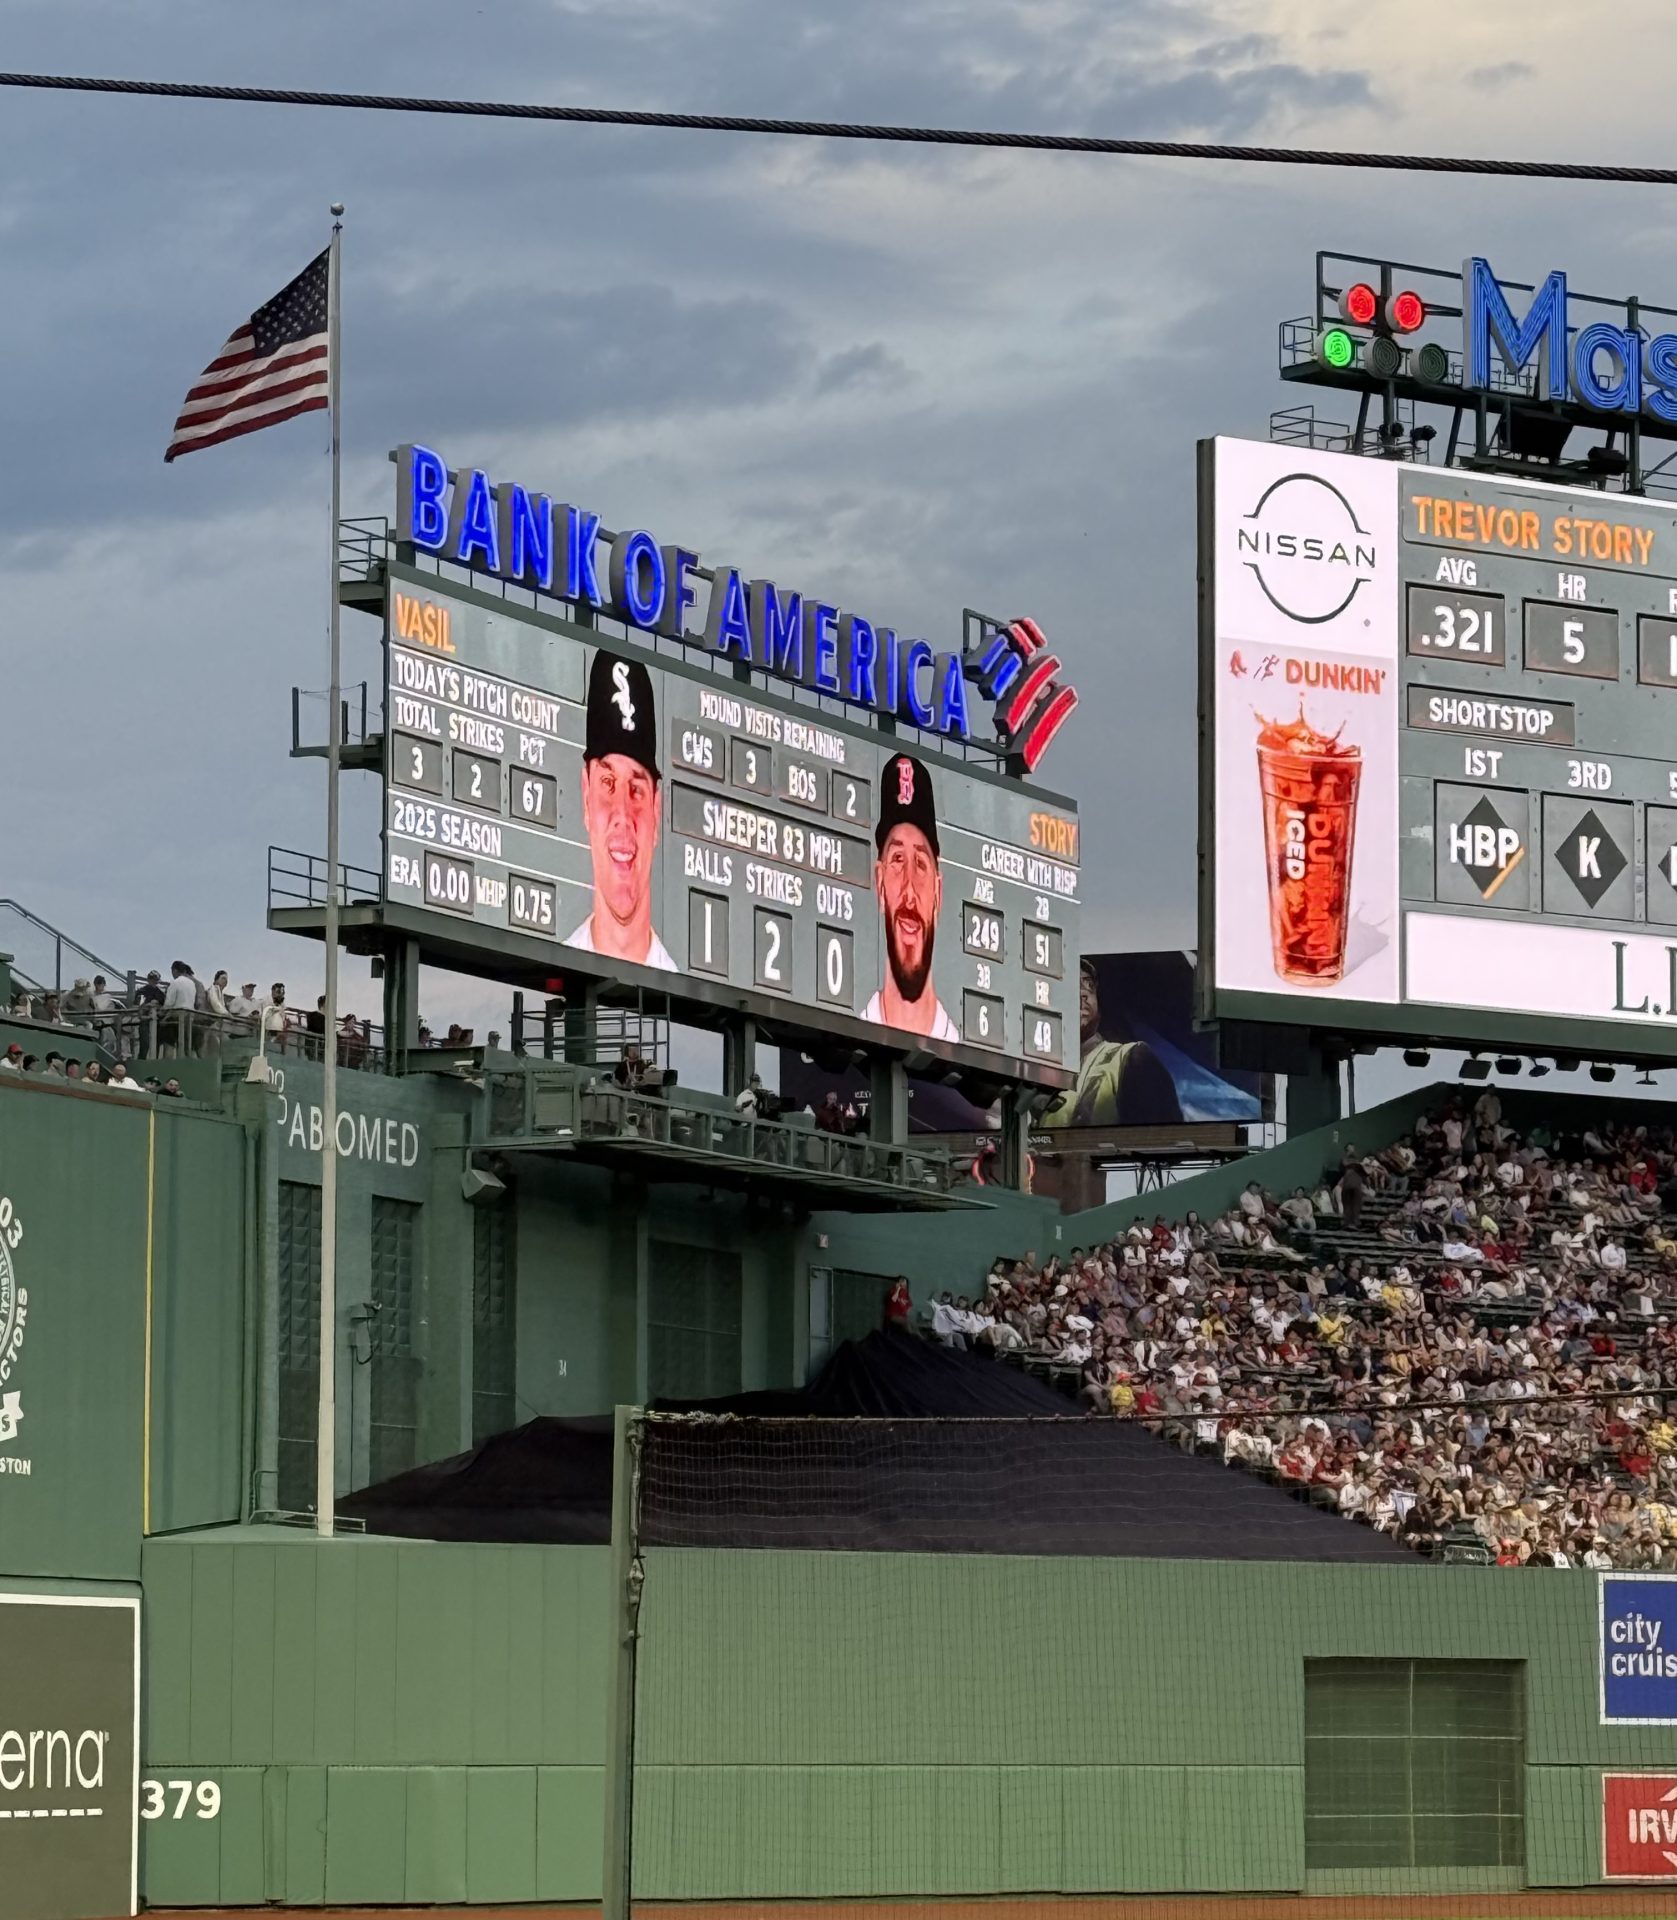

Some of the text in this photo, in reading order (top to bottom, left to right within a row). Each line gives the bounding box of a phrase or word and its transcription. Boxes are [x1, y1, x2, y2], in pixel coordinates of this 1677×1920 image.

[1238, 528, 1376, 568] NISSAN
[1411, 496, 1655, 566] TREVOR STORY
[400, 444, 971, 740] BANK OF AMERICA
[1436, 556, 1478, 587] AVG
[1557, 572, 1586, 602] HR
[395, 593, 456, 654] VASIL
[1421, 605, 1493, 654] .321
[1562, 620, 1585, 664] 5
[395, 653, 560, 734] TODAY'S PITCH COUNT
[1285, 658, 1387, 695] DUNKIN'
[395, 697, 547, 766] TOTAL STRIKES PCT
[700, 690, 846, 764] MOUND VISITS REMAINING
[1428, 696, 1554, 736] SHORTSTOP
[411, 747, 424, 780] 3
[470, 764, 482, 798] 2
[745, 750, 757, 784] 3
[788, 764, 817, 803] BOS
[846, 783, 858, 817] 2
[1567, 760, 1612, 791] 3RD
[522, 781, 544, 816] 67
[393, 799, 501, 857] 2025 SEASON
[703, 800, 844, 875] SWEEPER 83 MPH
[1029, 811, 1076, 857] STORY
[1286, 809, 1305, 880] ICED
[1449, 822, 1520, 870] HBP
[981, 844, 1024, 880] CAREER
[1027, 859, 1053, 889] WITH
[1579, 834, 1602, 879] K
[390, 854, 552, 924] ERA 0.00 WHIP 0.75
[684, 844, 853, 921] BALLS STRIKES OUTS
[966, 915, 1000, 953] .249
[1035, 933, 1049, 968] 51
[764, 920, 781, 981] 2
[826, 938, 844, 996] 0
[979, 1005, 989, 1037] 6
[289, 1102, 419, 1167] ABOMED
[1611, 1612, 1662, 1651] city
[1612, 1647, 1677, 1677] cruis
[0, 1730, 104, 1790] erna
[140, 1780, 221, 1819] 379
